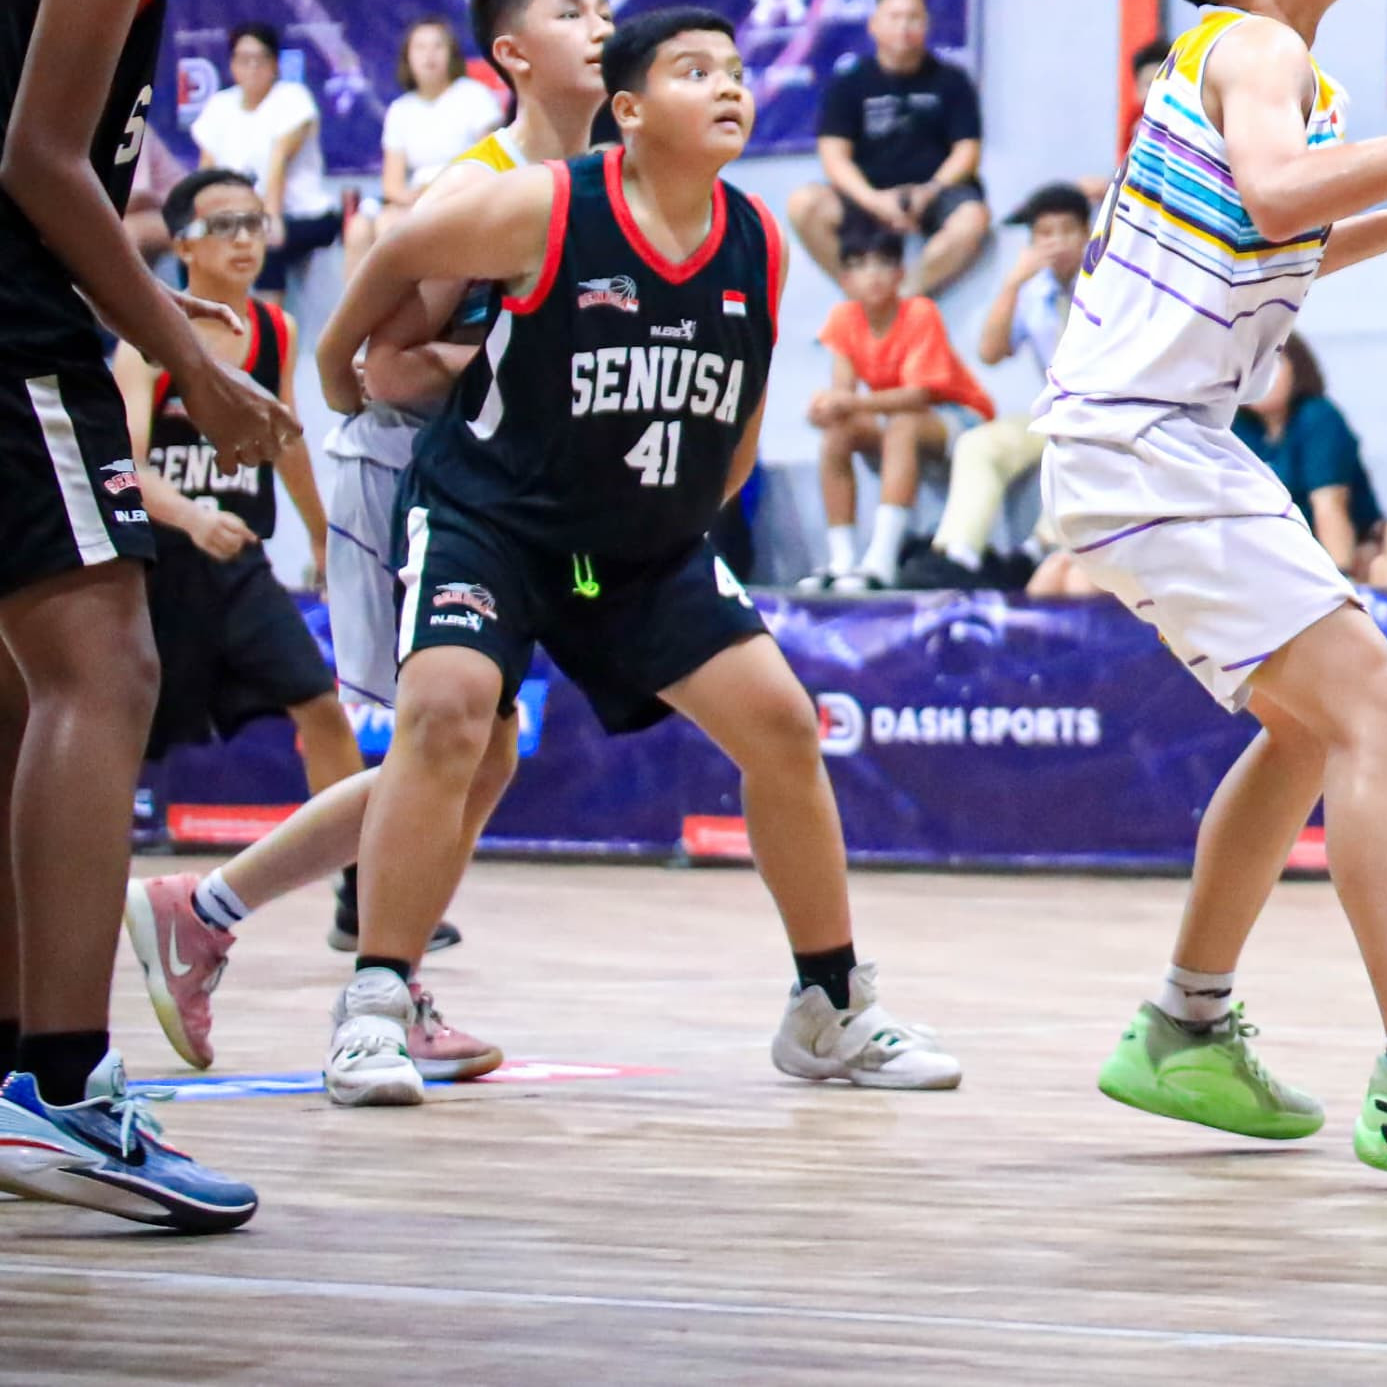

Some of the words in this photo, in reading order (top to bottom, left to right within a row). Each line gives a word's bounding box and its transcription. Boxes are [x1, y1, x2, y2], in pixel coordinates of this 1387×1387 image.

[571, 345, 745, 423] SENUSA
[623, 420, 681, 486] 41
[871, 706, 966, 744] DASH
[970, 706, 1100, 745] SPORTS
